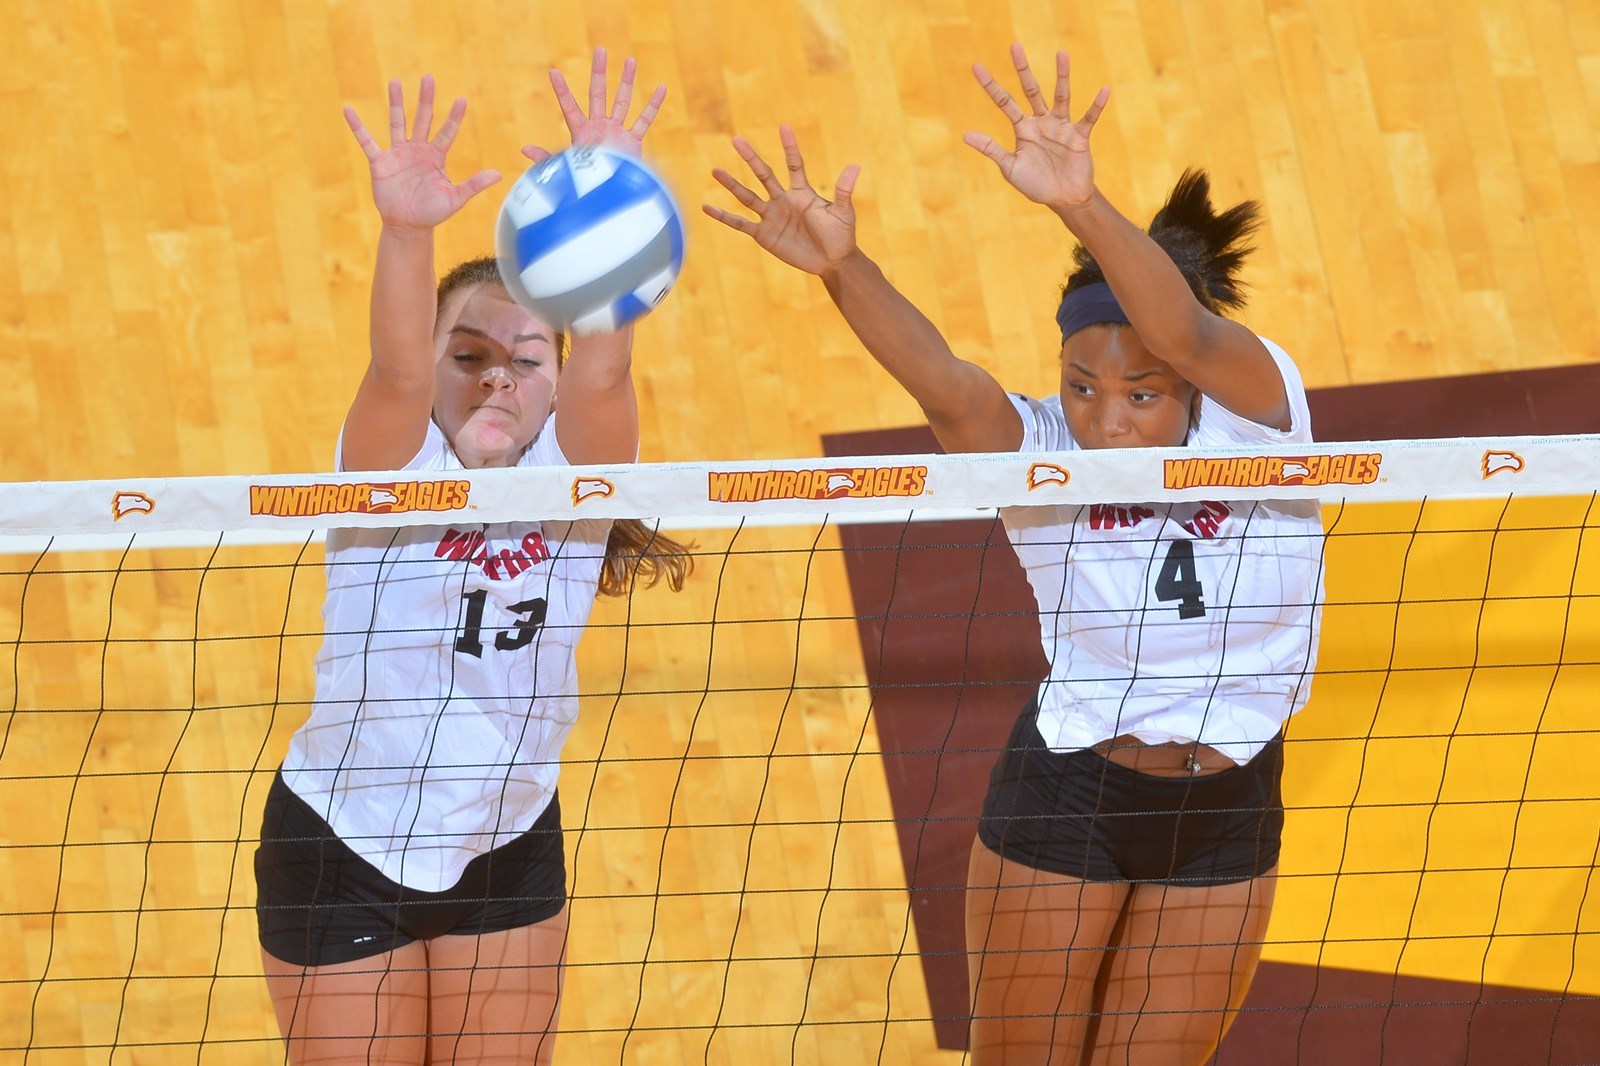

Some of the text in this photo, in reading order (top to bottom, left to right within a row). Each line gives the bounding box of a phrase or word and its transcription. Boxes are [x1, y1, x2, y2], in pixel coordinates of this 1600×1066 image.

[709, 469, 827, 502] WINTHROP
[849, 466, 928, 498] EAGLES
[1164, 456, 1282, 489] WINTHROP
[1304, 453, 1383, 486] EAGLES
[250, 484, 369, 516] WINTHROP
[393, 480, 471, 513] EAGLES
[1155, 539, 1206, 620] 4
[455, 589, 548, 659] 13
